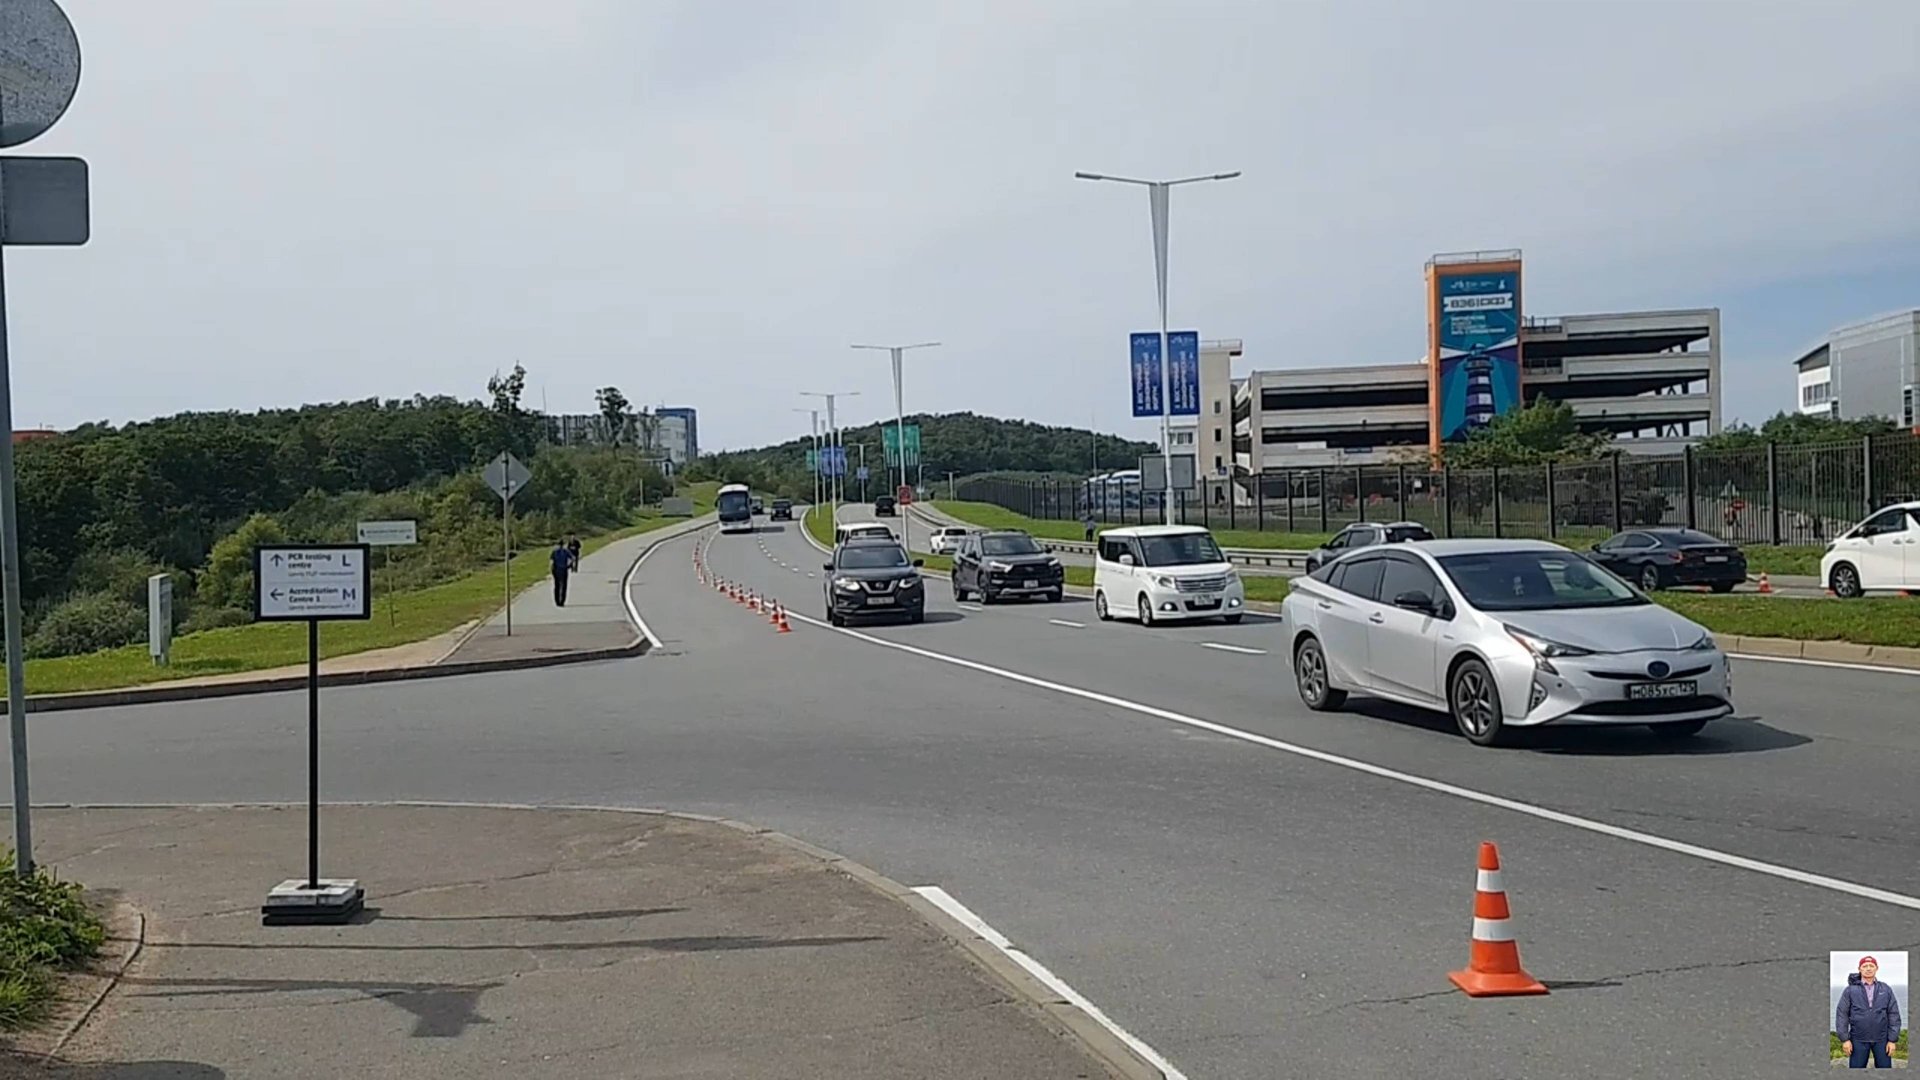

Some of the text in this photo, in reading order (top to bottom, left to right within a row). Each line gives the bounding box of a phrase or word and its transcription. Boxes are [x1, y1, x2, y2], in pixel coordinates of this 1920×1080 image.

[305, 553, 332, 561] testing
[342, 554, 351, 567] L
[289, 587, 338, 595] Accreditation
[342, 588, 356, 600] M
[289, 595, 314, 603] Centre
